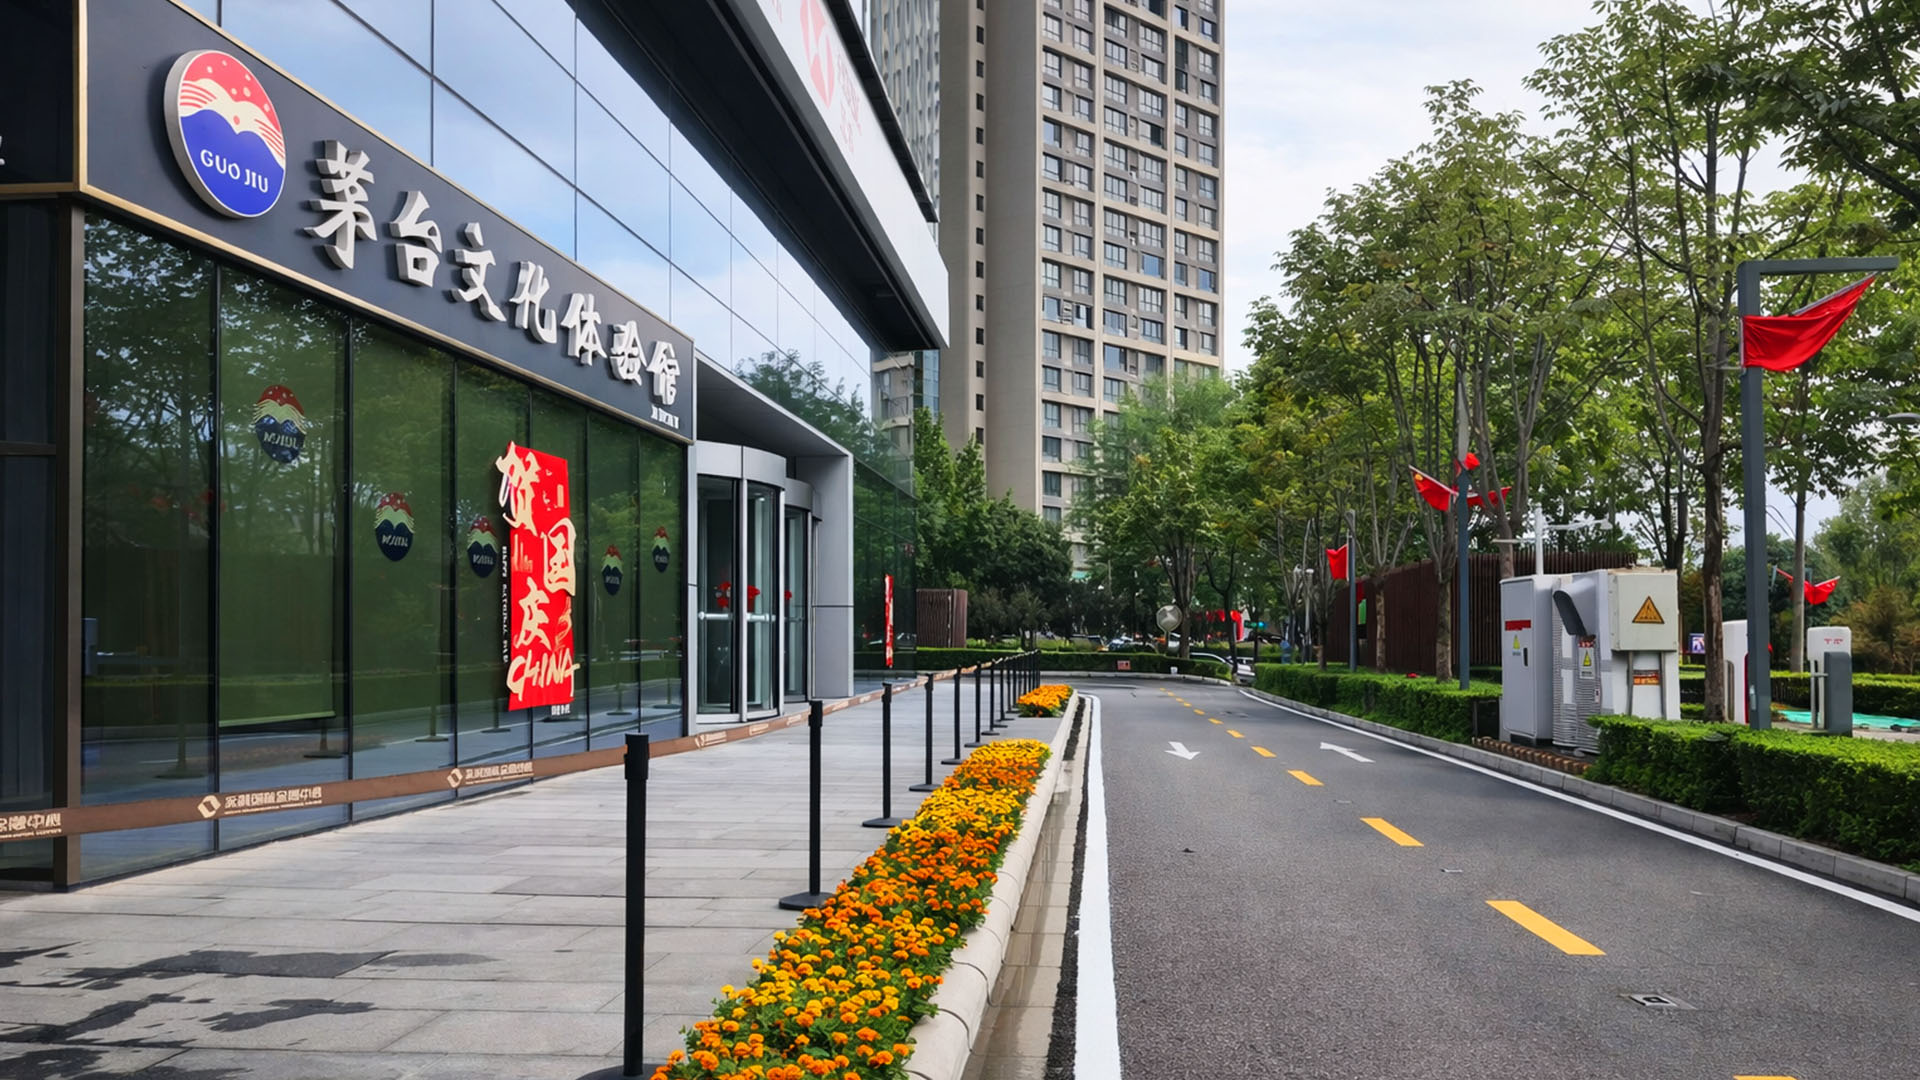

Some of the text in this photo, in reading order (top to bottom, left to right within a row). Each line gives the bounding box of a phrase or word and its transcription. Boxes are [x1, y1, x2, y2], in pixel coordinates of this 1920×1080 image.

[200, 149, 268, 193] GUO JIU
[304, 140, 681, 405] 茅台文化体验馆
[506, 648, 580, 702] CHINA
